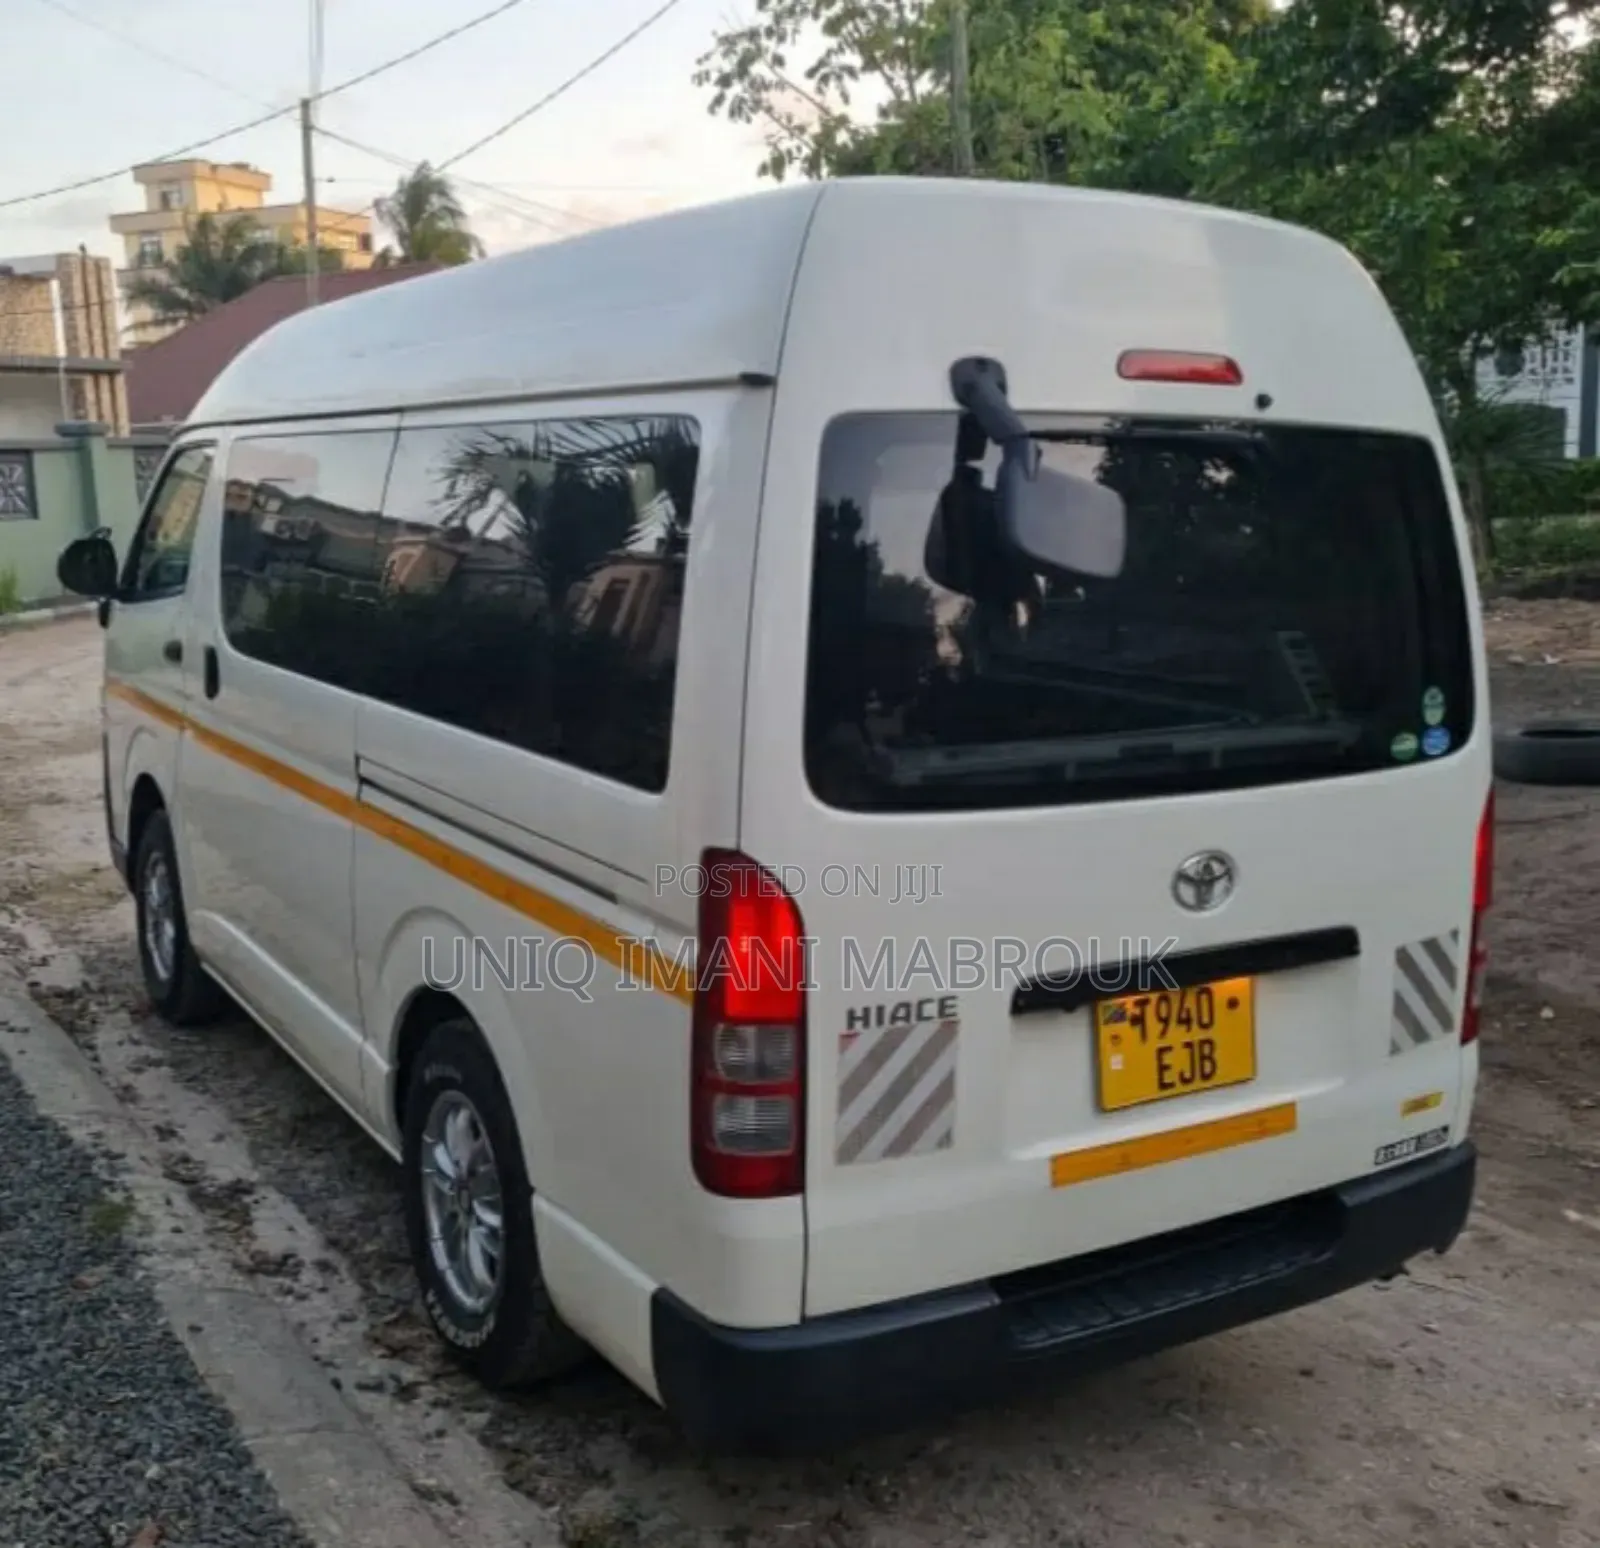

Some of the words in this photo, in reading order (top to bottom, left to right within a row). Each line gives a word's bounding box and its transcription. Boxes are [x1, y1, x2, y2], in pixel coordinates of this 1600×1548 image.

[846, 994, 959, 1030] HIACE
[1131, 986, 1215, 1043] T940
[1155, 1038, 1217, 1091] EJB
